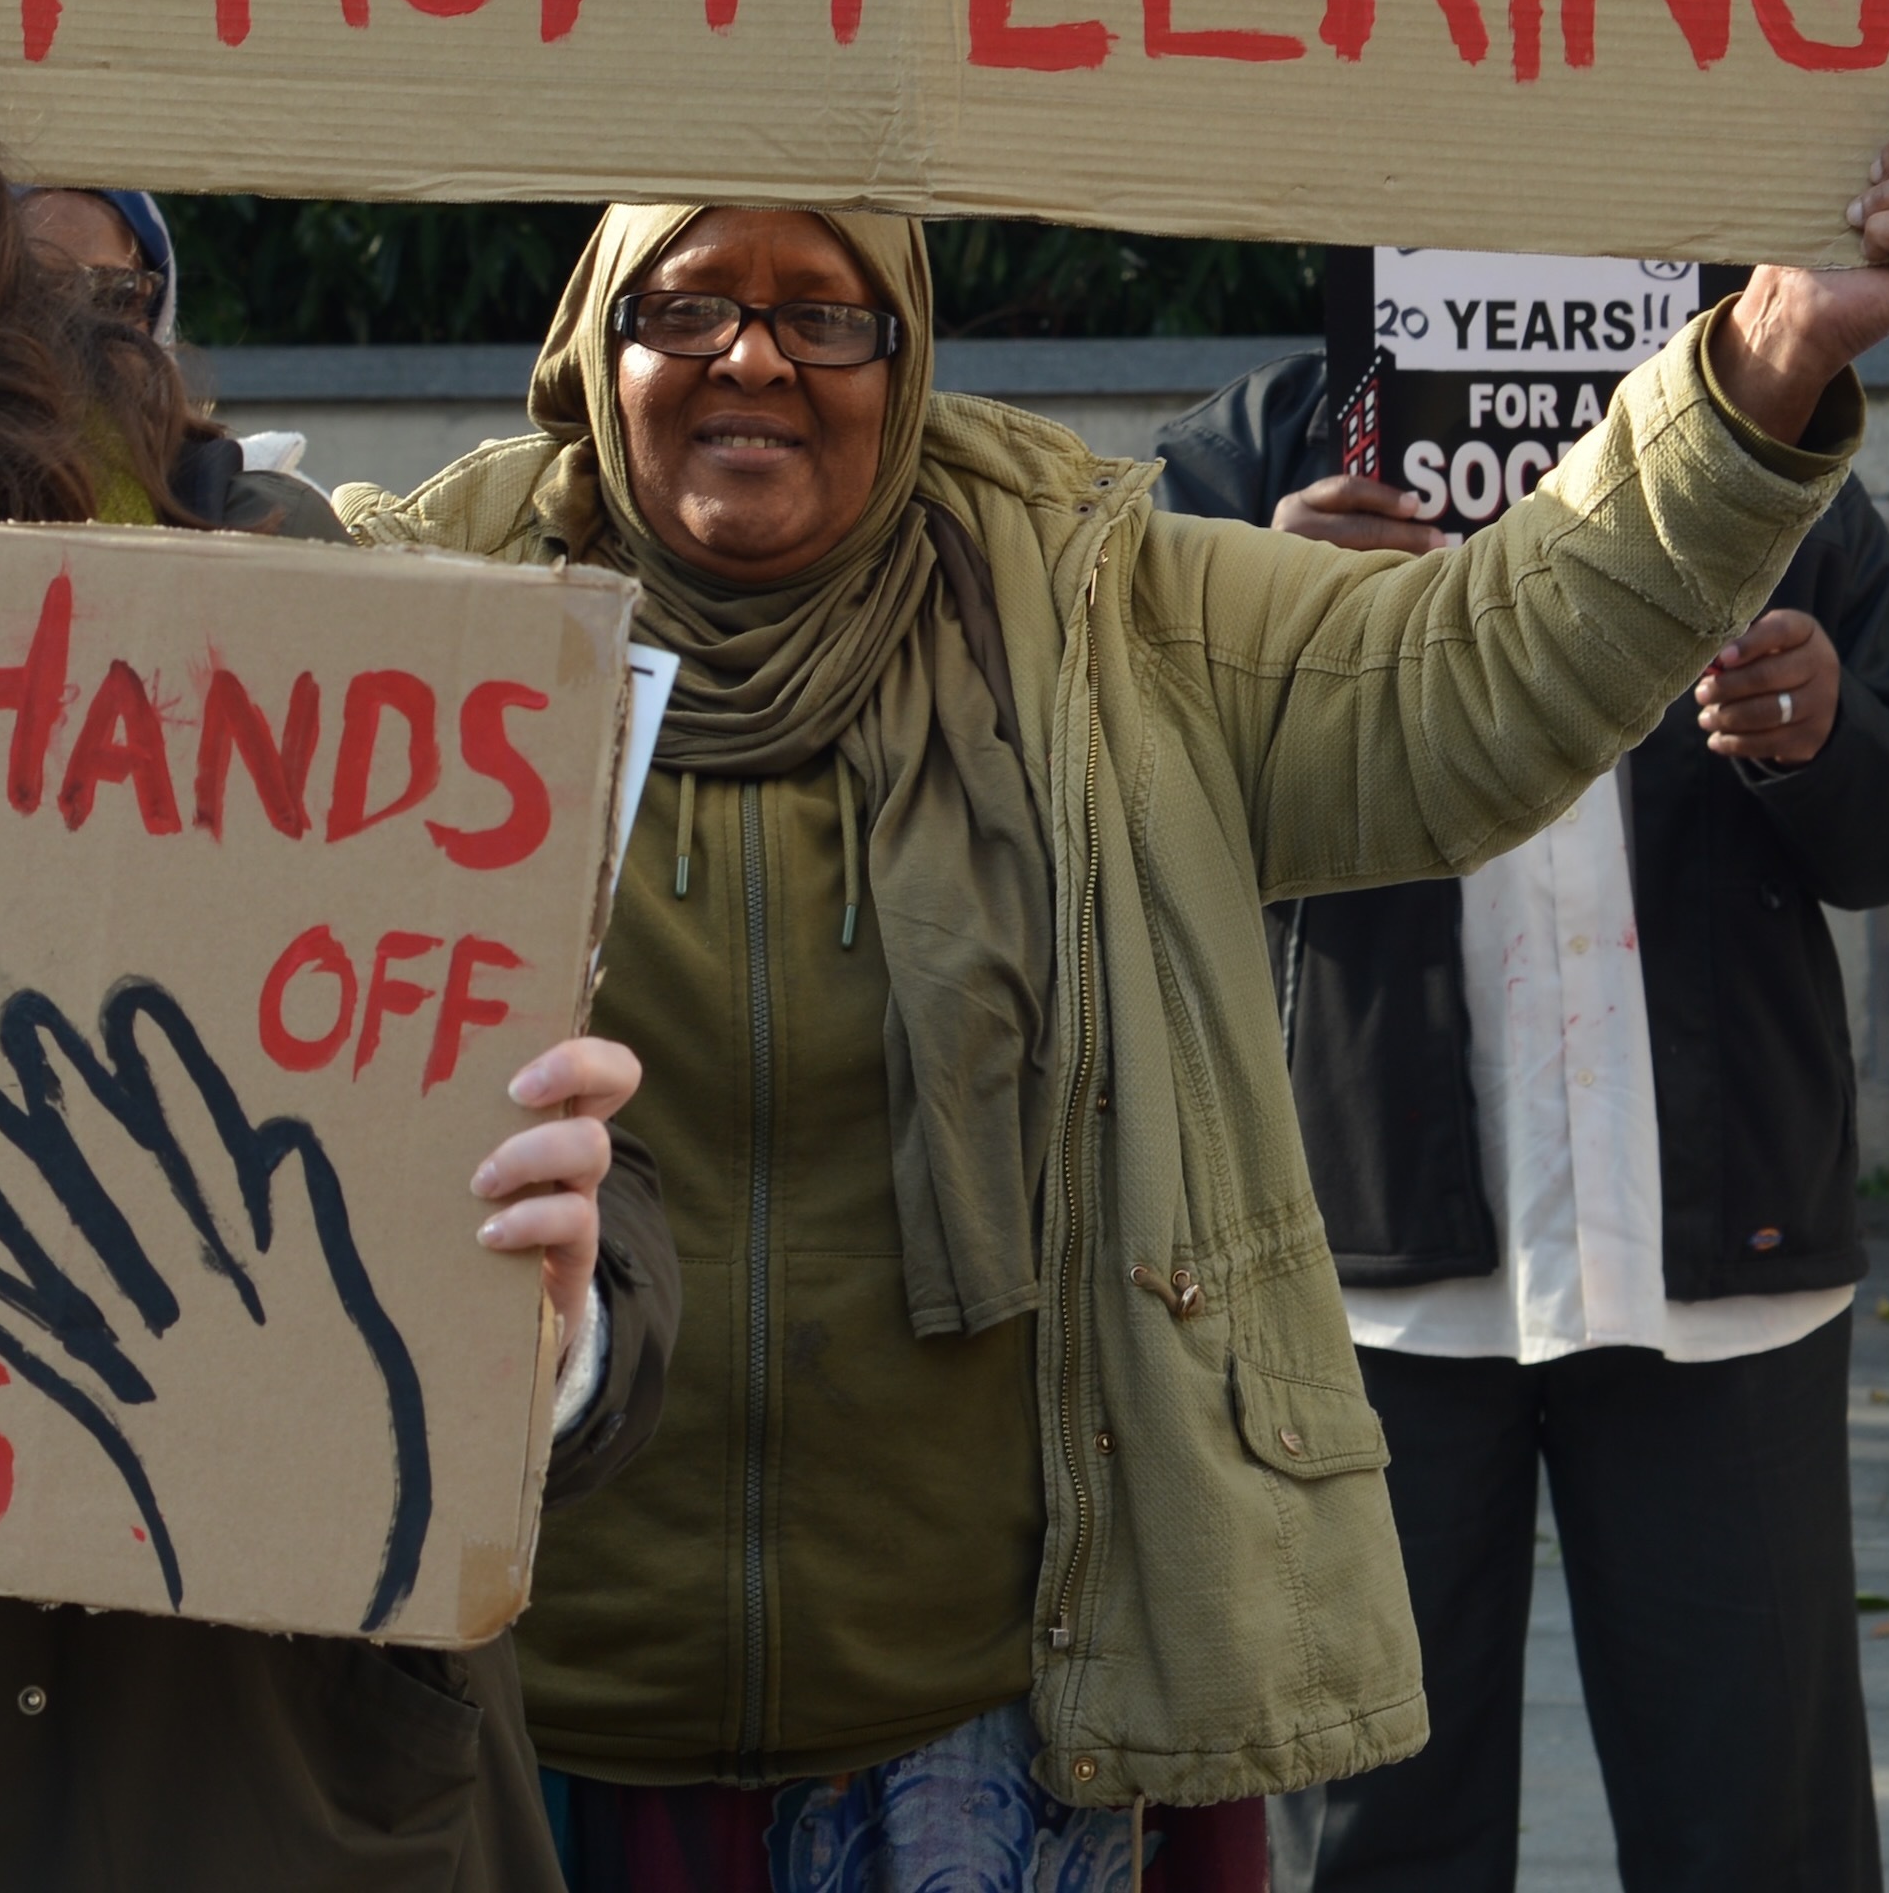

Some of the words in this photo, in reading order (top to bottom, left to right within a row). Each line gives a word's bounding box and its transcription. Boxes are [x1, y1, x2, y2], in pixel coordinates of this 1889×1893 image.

[1375, 298, 1429, 340] 20
[1469, 383, 1559, 429] FOR
[1571, 383, 1605, 429] A
[1403, 440, 1572, 522] SOC
[258, 924, 526, 1096] OFF
